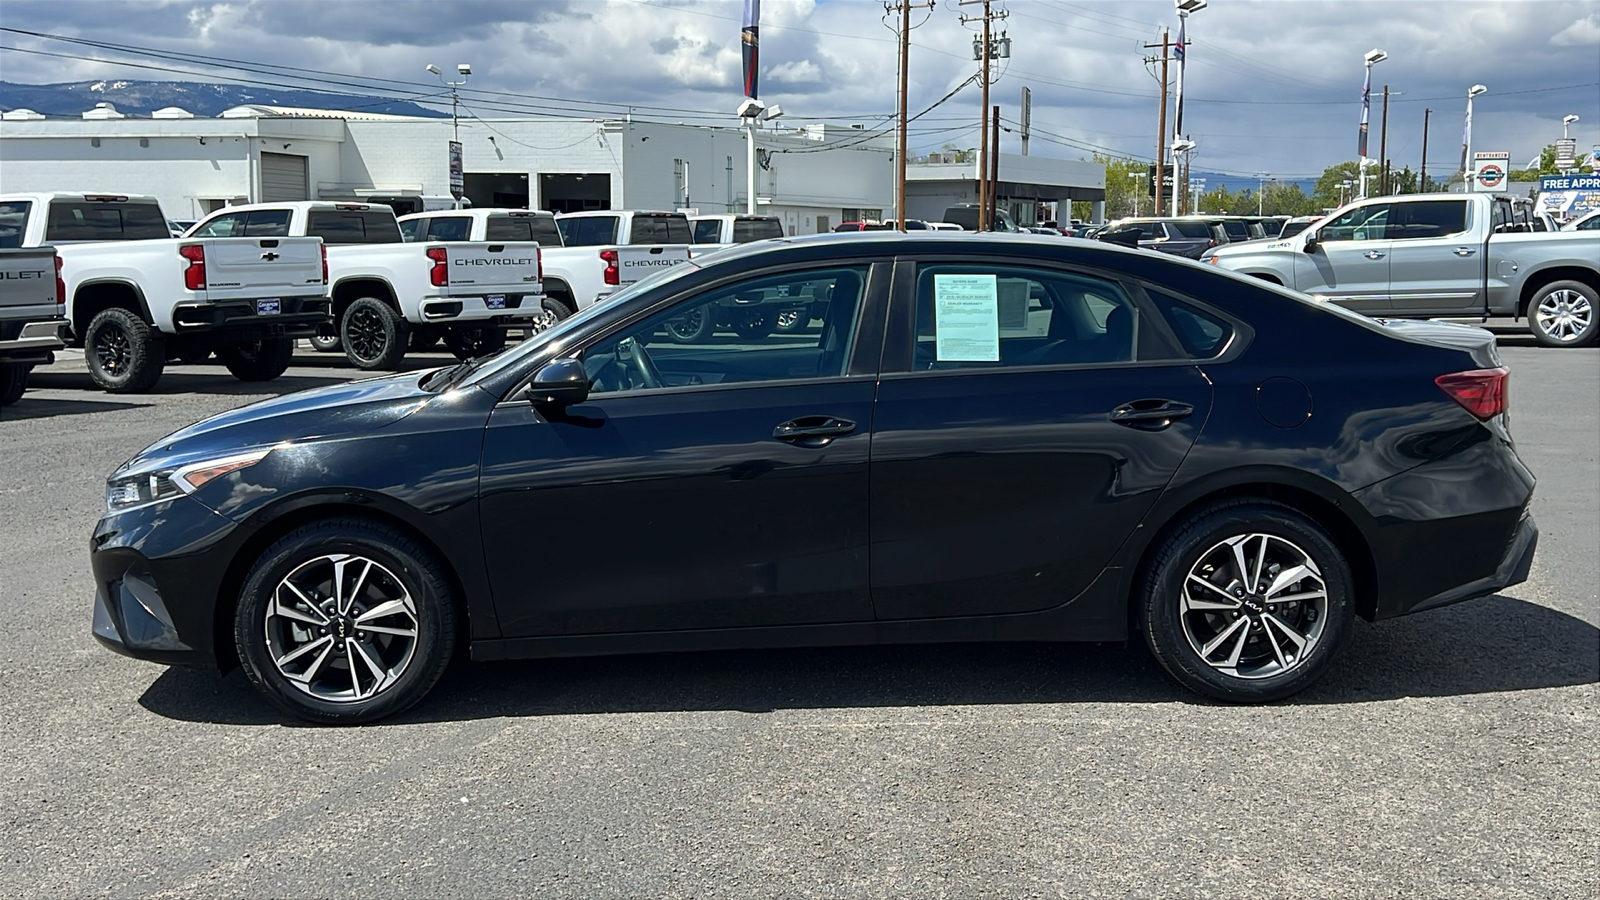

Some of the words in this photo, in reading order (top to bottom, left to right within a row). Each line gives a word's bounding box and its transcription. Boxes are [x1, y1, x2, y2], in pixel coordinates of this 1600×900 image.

[1543, 179, 1570, 189] FREE
[454, 258, 533, 266] CHEVROLET
[0, 270, 45, 280] LET
